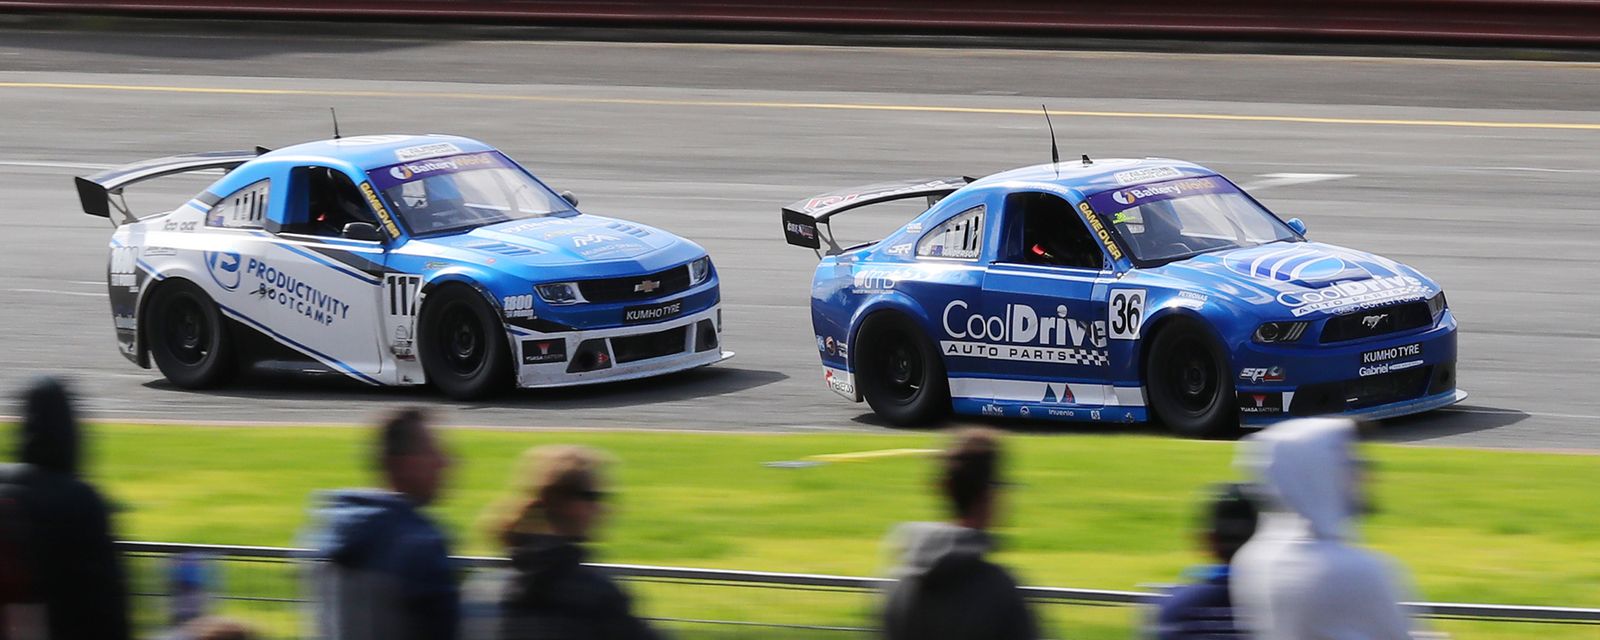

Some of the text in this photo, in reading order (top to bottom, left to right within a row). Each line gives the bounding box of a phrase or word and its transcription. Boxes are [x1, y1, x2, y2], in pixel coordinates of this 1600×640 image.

[247, 258, 350, 319] PRODUCTIVITY
[259, 283, 333, 327] BOOTCAMP
[387, 276, 420, 316] 117
[1276, 274, 1423, 307] CoolDrive
[1298, 289, 1401, 315] AUTO PARTS
[626, 302, 681, 320] KUMHO TYRE
[942, 299, 1108, 348] CoolDrive
[1112, 293, 1142, 335] 36
[947, 344, 1067, 361] AUTO PARTS
[1363, 343, 1420, 363] KUMHO TYRE
[1358, 363, 1389, 377] Gabriel
